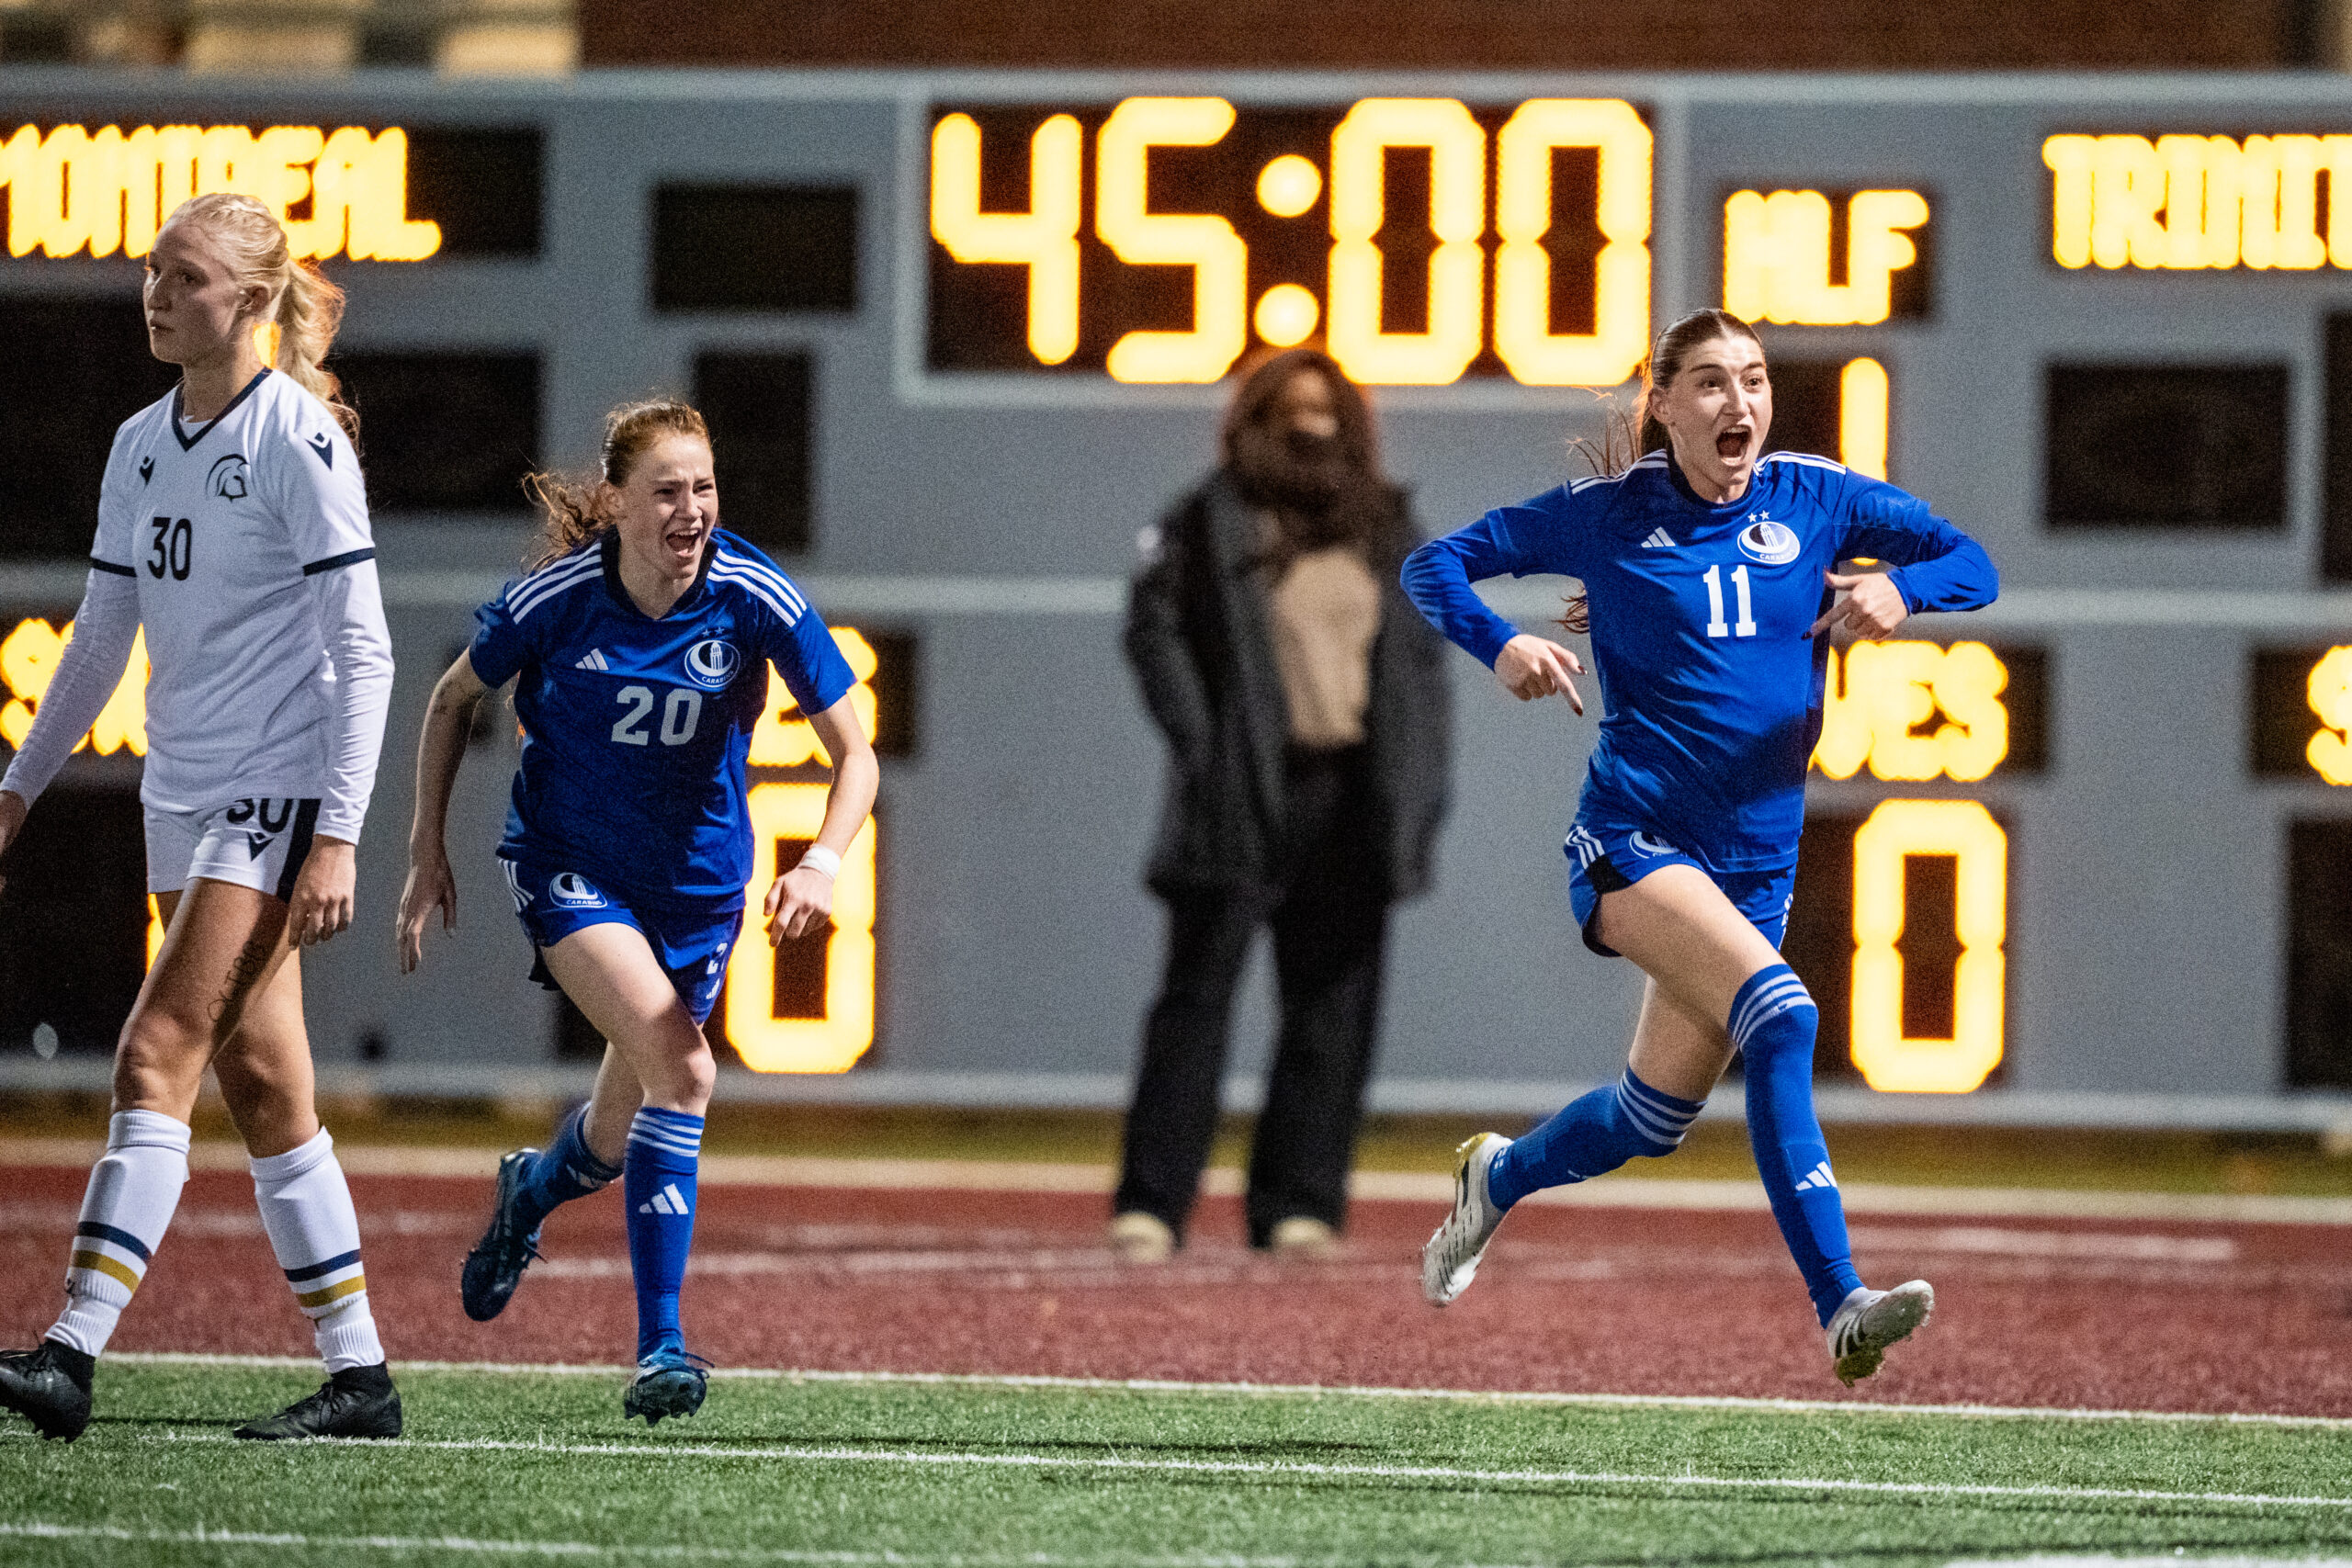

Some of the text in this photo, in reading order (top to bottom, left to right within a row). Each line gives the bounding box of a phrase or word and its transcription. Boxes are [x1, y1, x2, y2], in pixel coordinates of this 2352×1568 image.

[931, 96, 1653, 385] 45:00
[147, 516, 193, 581] 30
[1703, 564, 1756, 637] 11
[613, 686, 702, 745] 20
[726, 783, 877, 1074] 0
[1850, 798, 2007, 1094] 0
